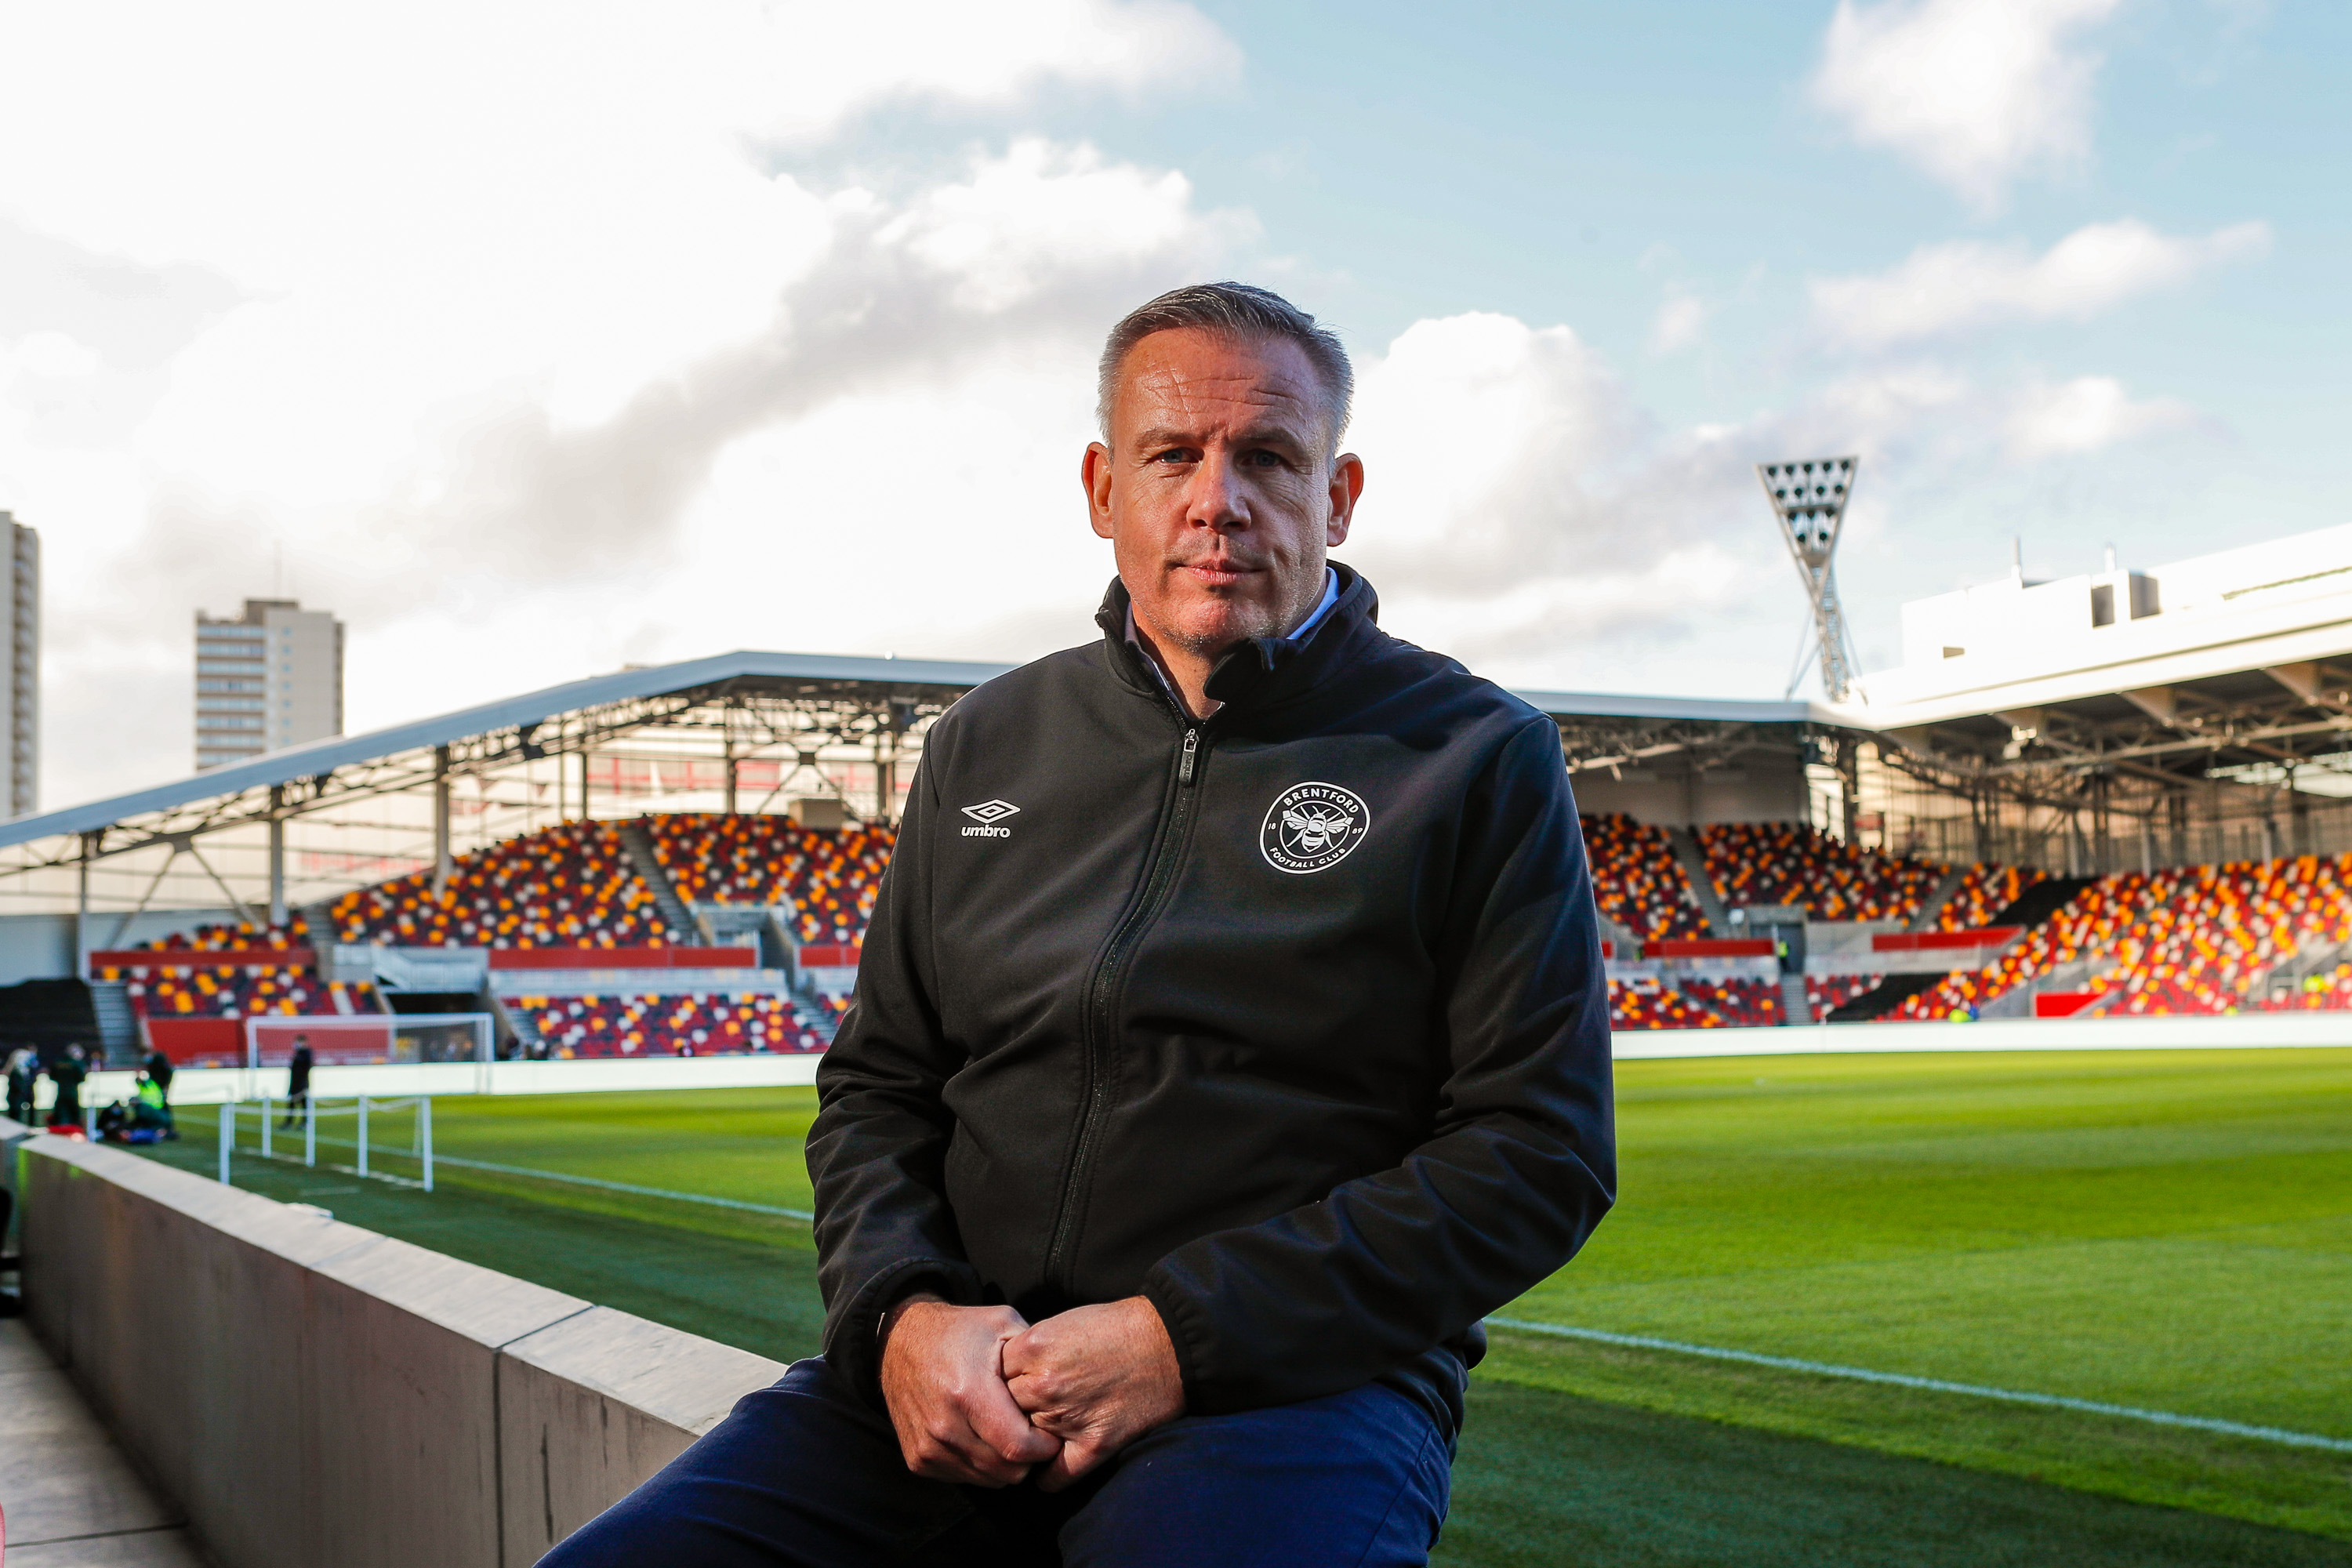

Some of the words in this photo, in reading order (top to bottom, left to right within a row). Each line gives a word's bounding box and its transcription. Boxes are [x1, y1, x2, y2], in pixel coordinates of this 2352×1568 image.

[1283, 788, 1360, 814] BRENTFORD
[960, 824, 1011, 838] umbro
[1269, 847, 1315, 868] FOOTBALL
[1319, 848, 1346, 865] CLUB
